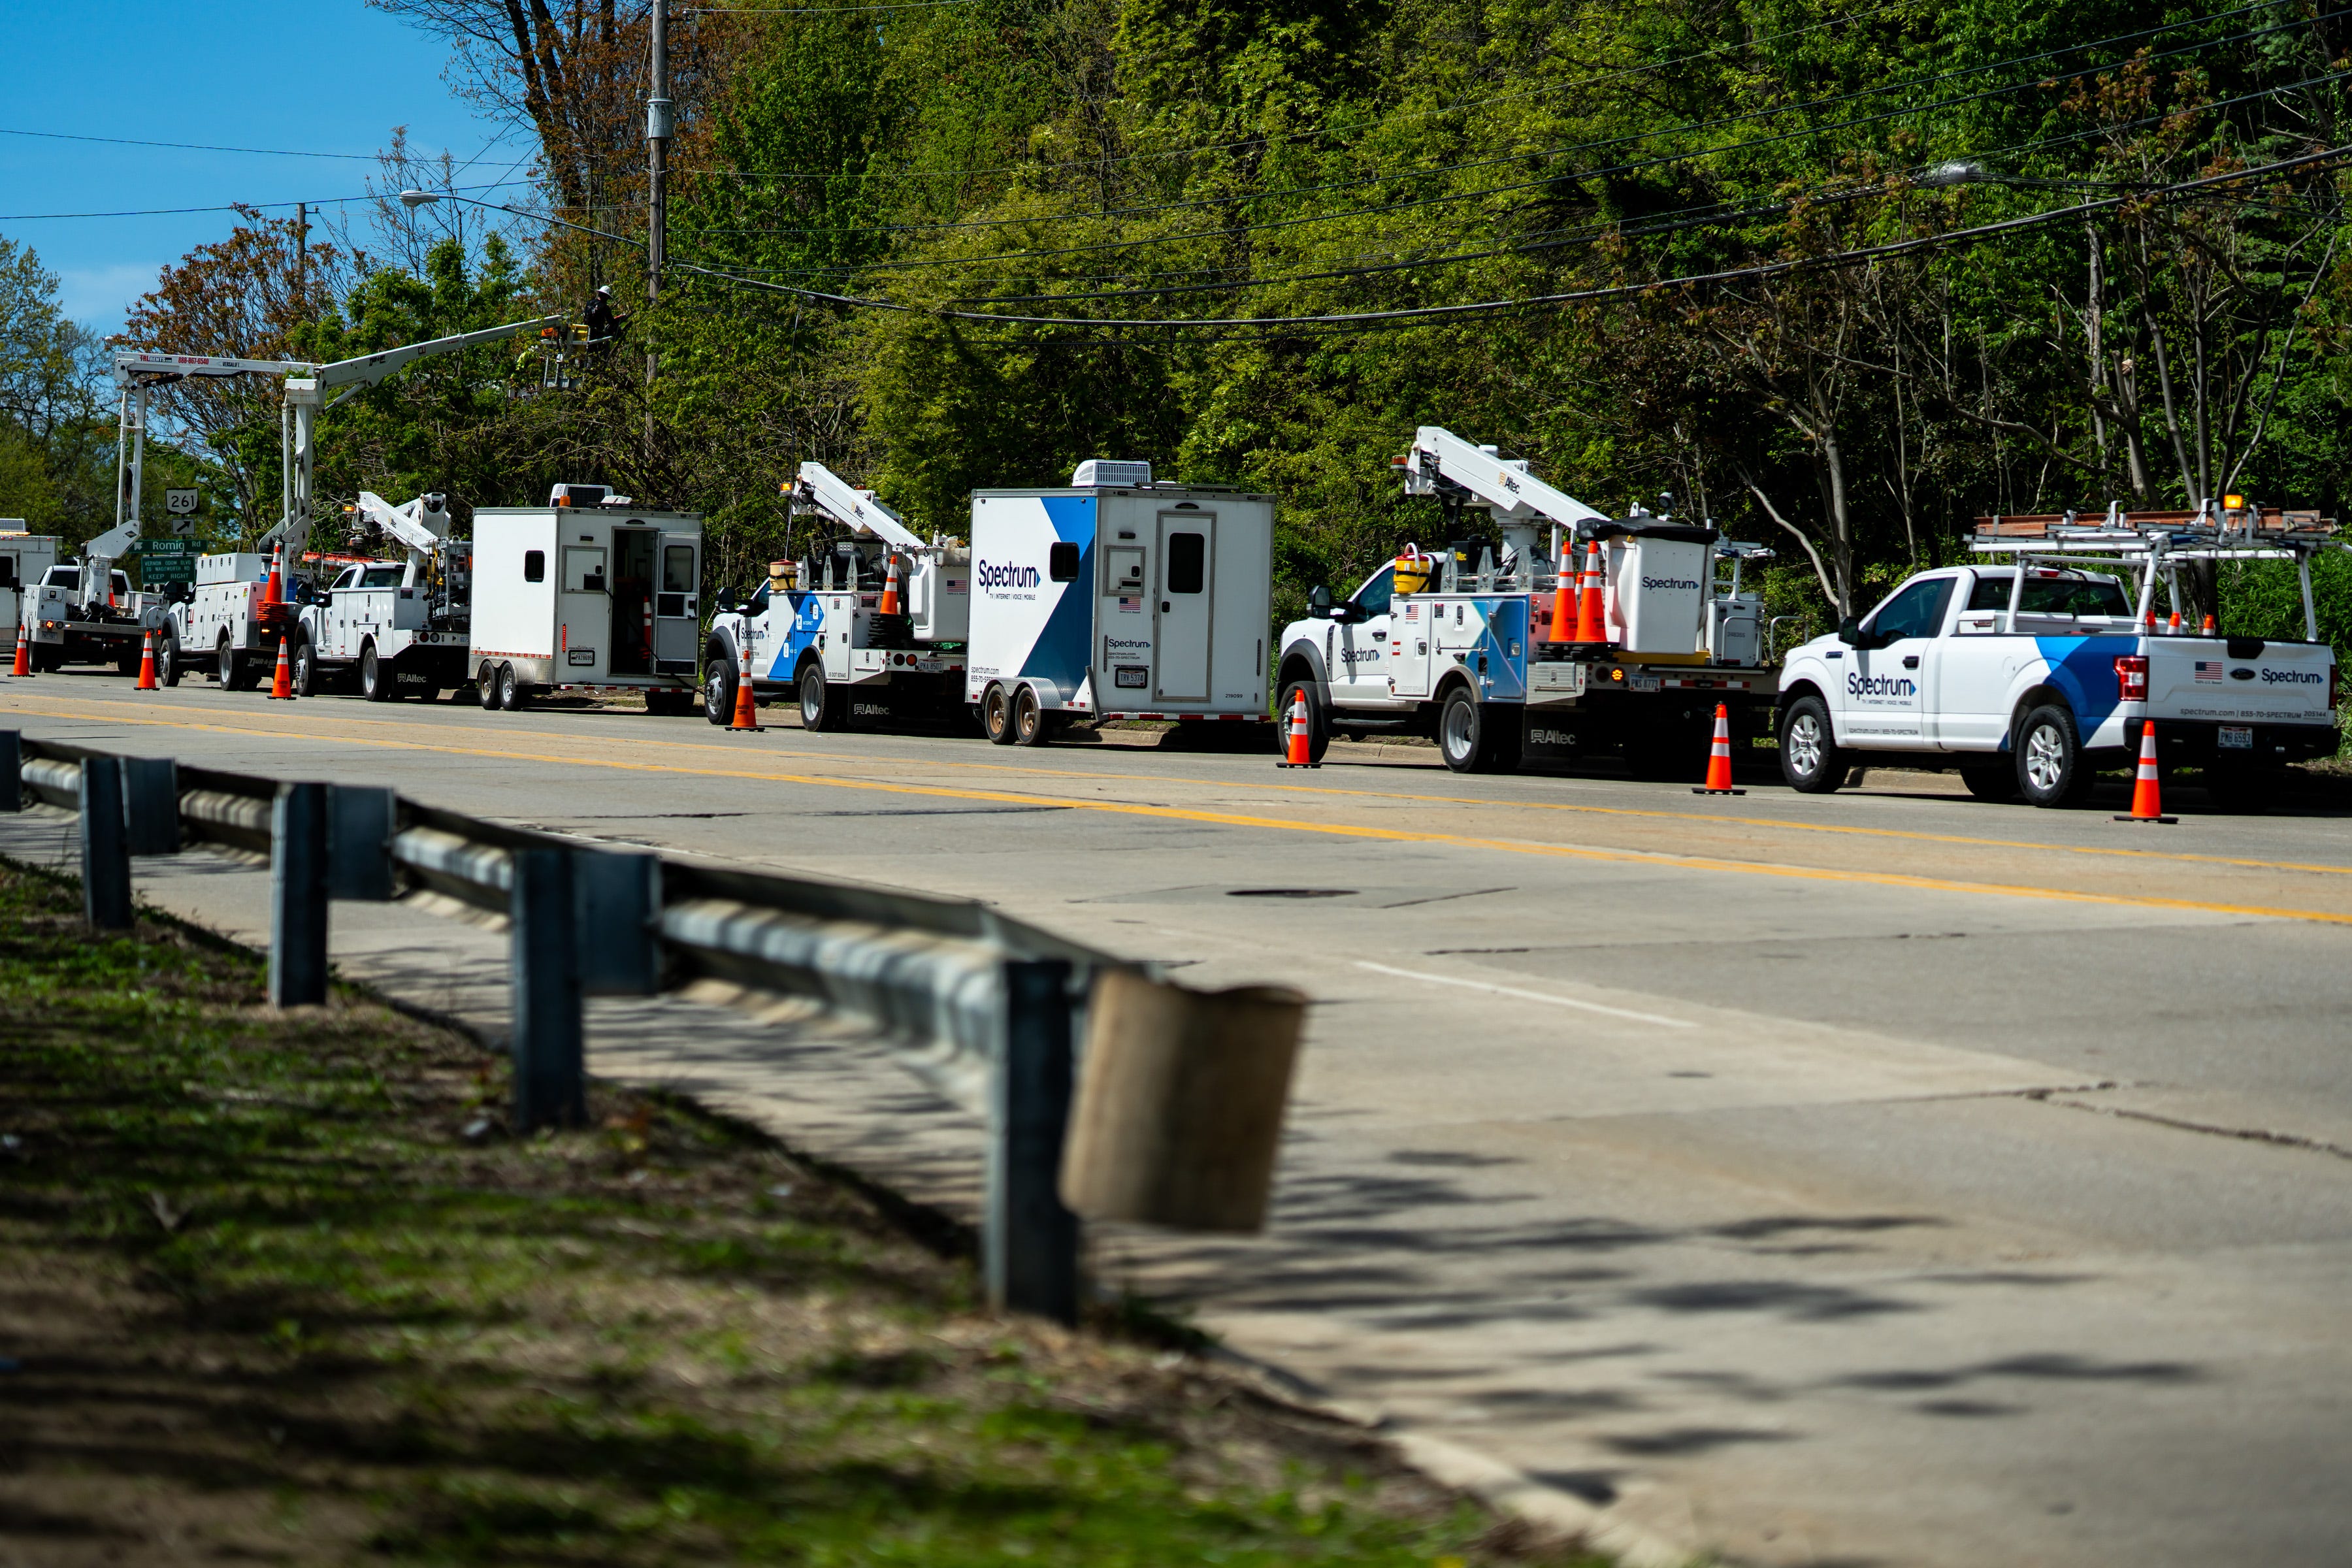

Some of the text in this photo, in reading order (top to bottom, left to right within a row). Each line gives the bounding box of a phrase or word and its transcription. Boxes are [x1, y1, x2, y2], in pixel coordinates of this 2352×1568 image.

[1504, 476, 1520, 495] Altec
[171, 495, 194, 508] 261
[855, 504, 864, 519] Altec
[152, 540, 185, 551] Romig
[979, 559, 1037, 594] Spectrum
[1642, 576, 1695, 591] Spectrum
[741, 628, 764, 642] Spectrum
[1109, 639, 1149, 649] Spectrum
[1341, 647, 1379, 666] Spectrum
[406, 674, 427, 683] Altec
[2262, 668, 2320, 685] Spectrum
[1848, 672, 1912, 700] Spectrum
[864, 704, 889, 715] Altec
[2180, 708, 2235, 717] spectrum.com
[1545, 730, 1575, 744] Altec
[2221, 732, 2251, 743] PMB 6593
